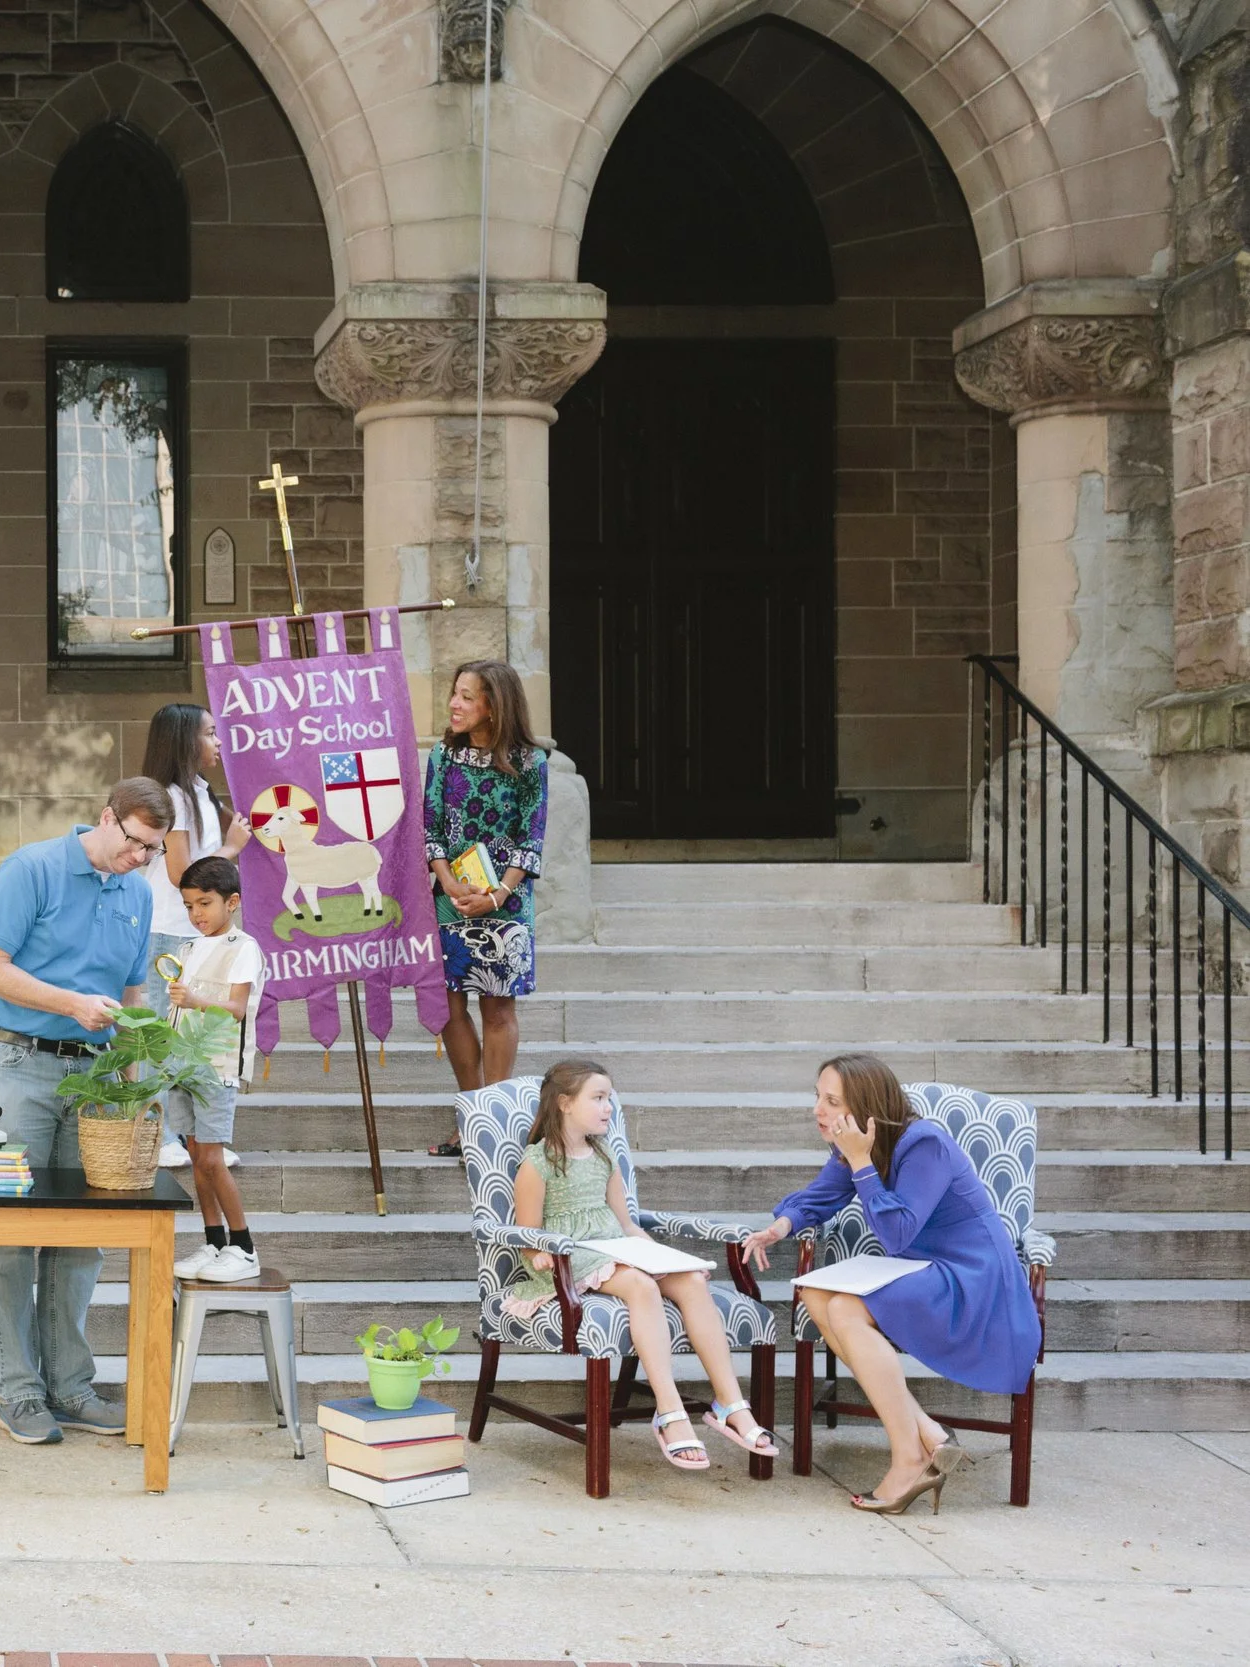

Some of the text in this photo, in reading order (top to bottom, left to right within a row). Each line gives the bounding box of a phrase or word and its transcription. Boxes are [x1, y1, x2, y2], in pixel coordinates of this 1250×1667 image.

[220, 665, 386, 718] ADVENT
[229, 709, 395, 760] Day School
